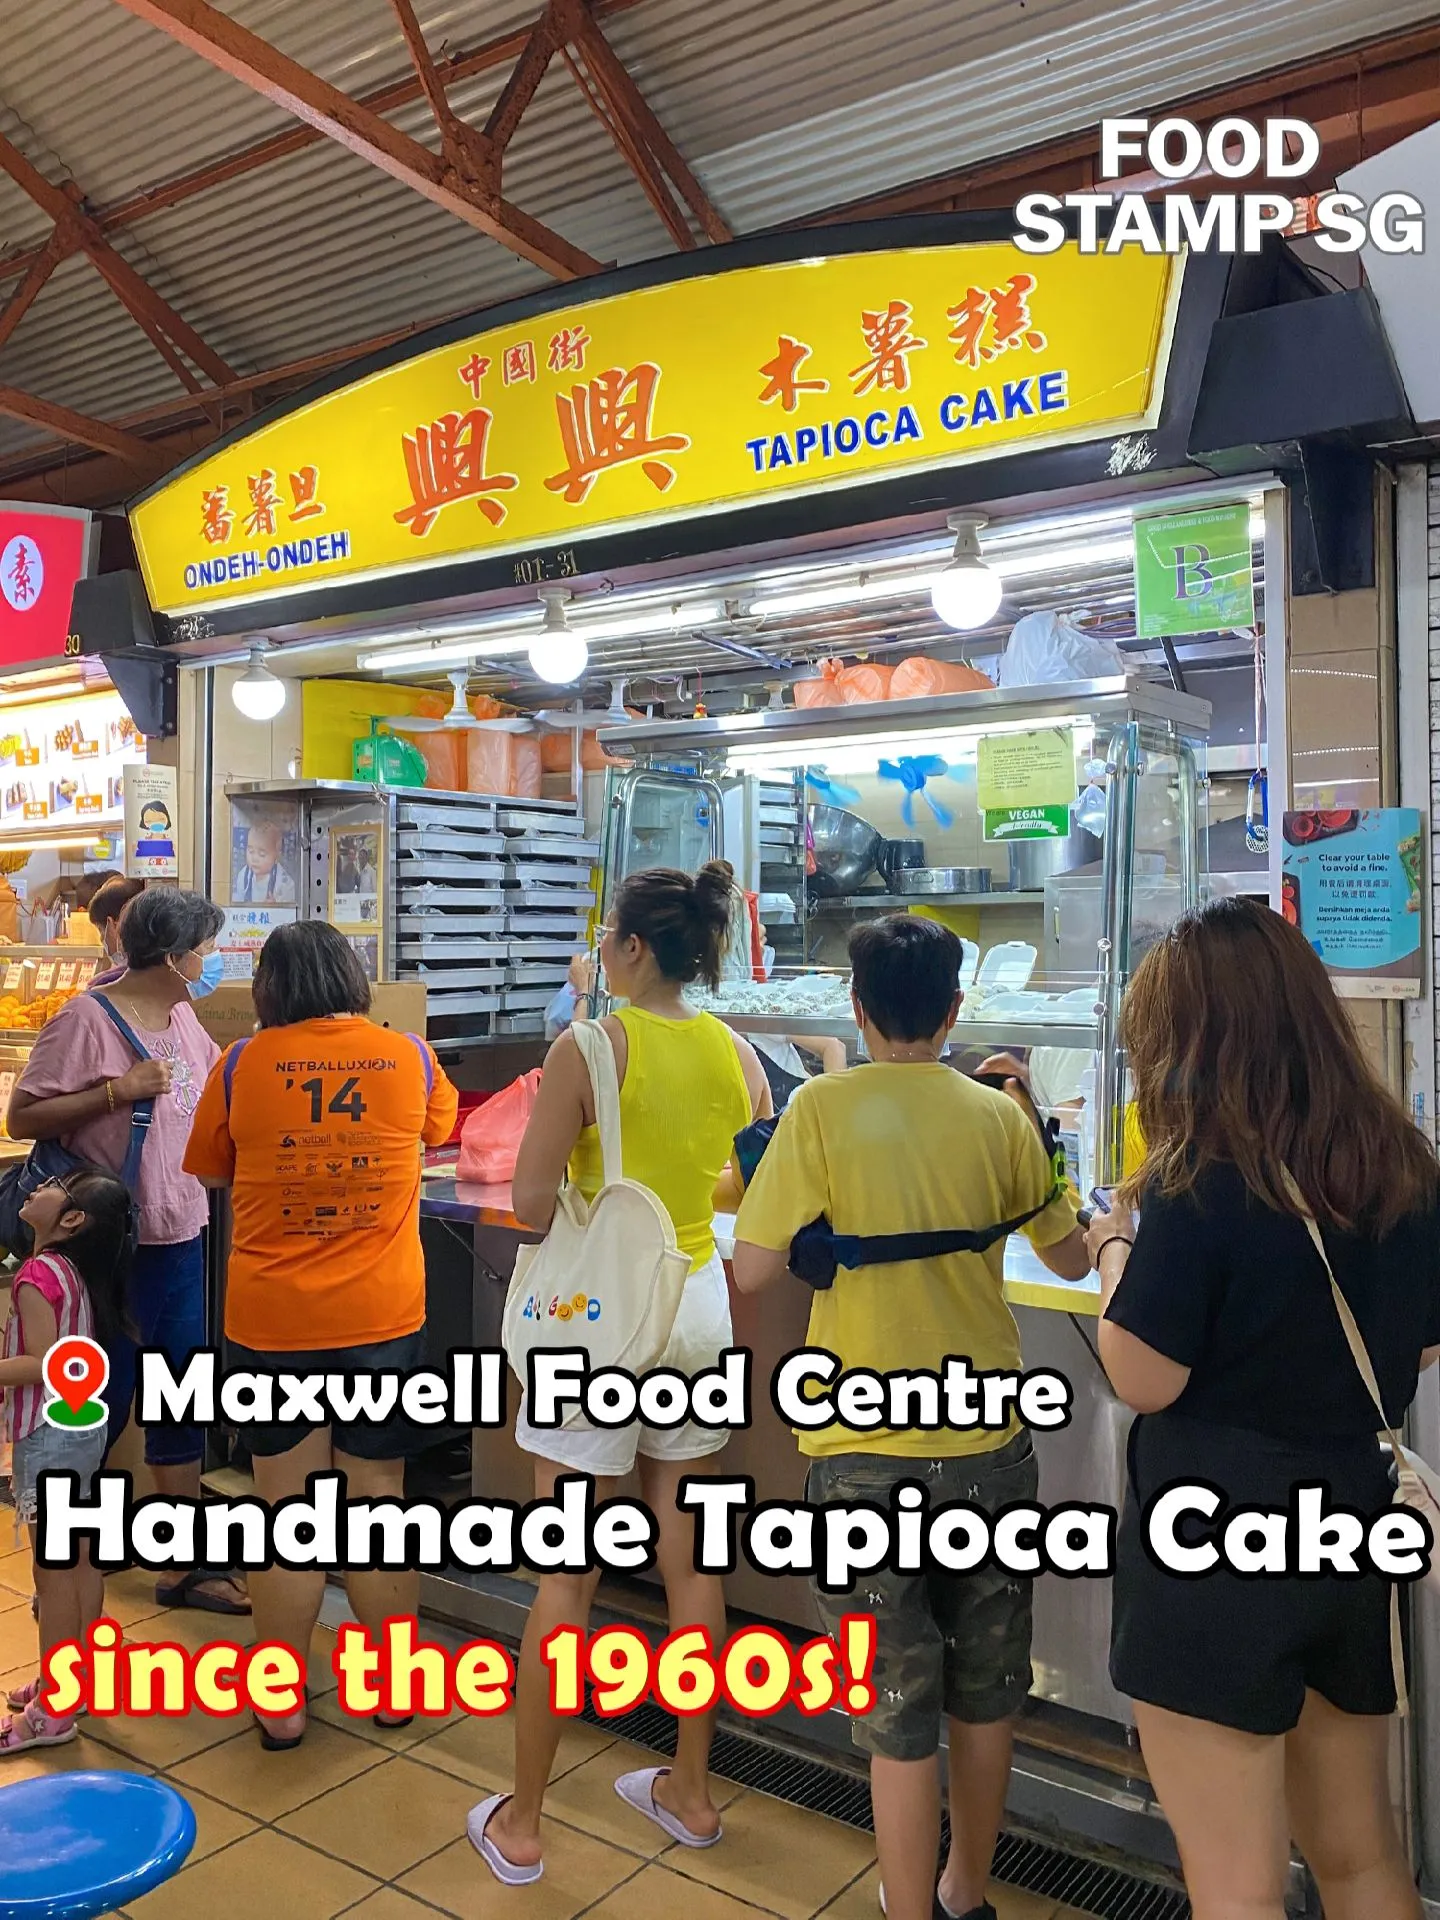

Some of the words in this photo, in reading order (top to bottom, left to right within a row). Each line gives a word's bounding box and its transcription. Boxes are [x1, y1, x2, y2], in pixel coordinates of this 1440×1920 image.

[459, 326, 591, 400] 中國街
[757, 273, 1047, 412] 木薯糕
[746, 405, 921, 473] TAPIOCA
[938, 369, 1070, 431] CAKE
[393, 362, 692, 537] 興興
[8, 543, 35, 603] 素
[183, 529, 351, 589] ONDEH-ONDEH
[1173, 544, 1213, 600] B
[1009, 808, 1046, 820] VEGAN
[1333, 864, 1358, 872] avoid
[1369, 863, 1388, 872] fine.
[1345, 855, 1365, 863] your
[1367, 853, 1390, 861] table
[276, 1059, 396, 1072] NETBALLUXION
[286, 1076, 367, 1123] '14
[299, 1134, 331, 1145] netball
